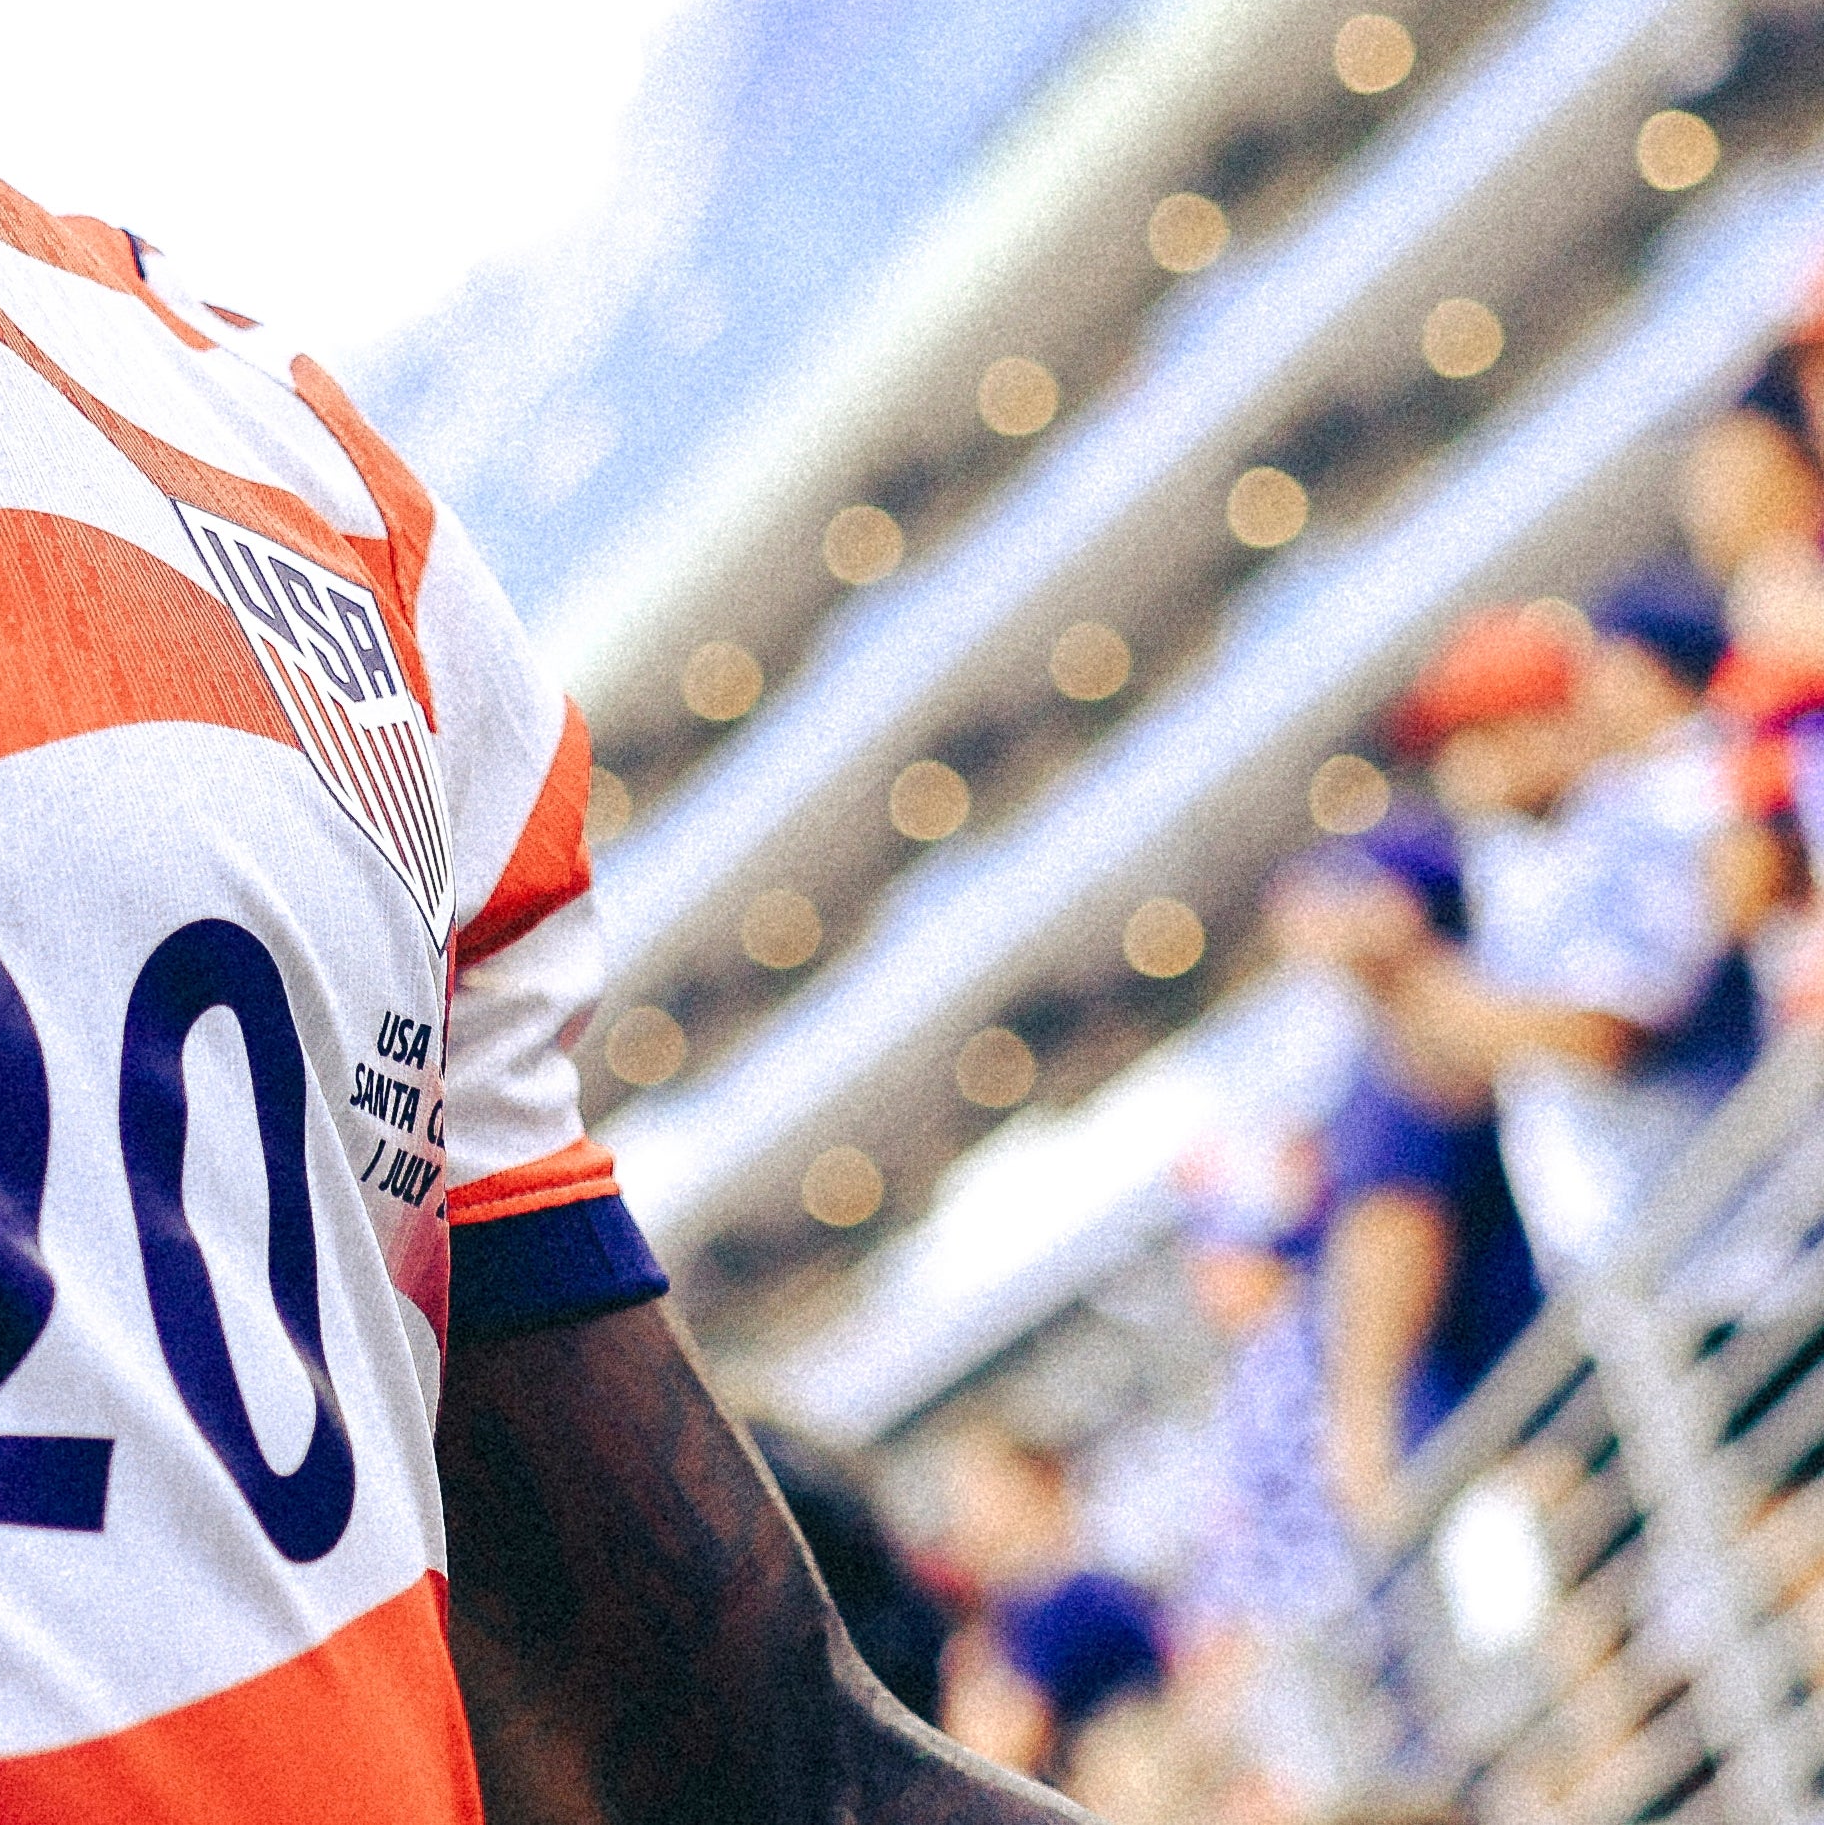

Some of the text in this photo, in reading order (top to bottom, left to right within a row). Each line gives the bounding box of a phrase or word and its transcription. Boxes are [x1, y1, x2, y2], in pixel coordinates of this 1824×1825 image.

[202, 527, 397, 702] USA
[377, 1011, 432, 1070] USA
[350, 1063, 421, 1134] SANTA
[378, 1148, 442, 1207] JULY
